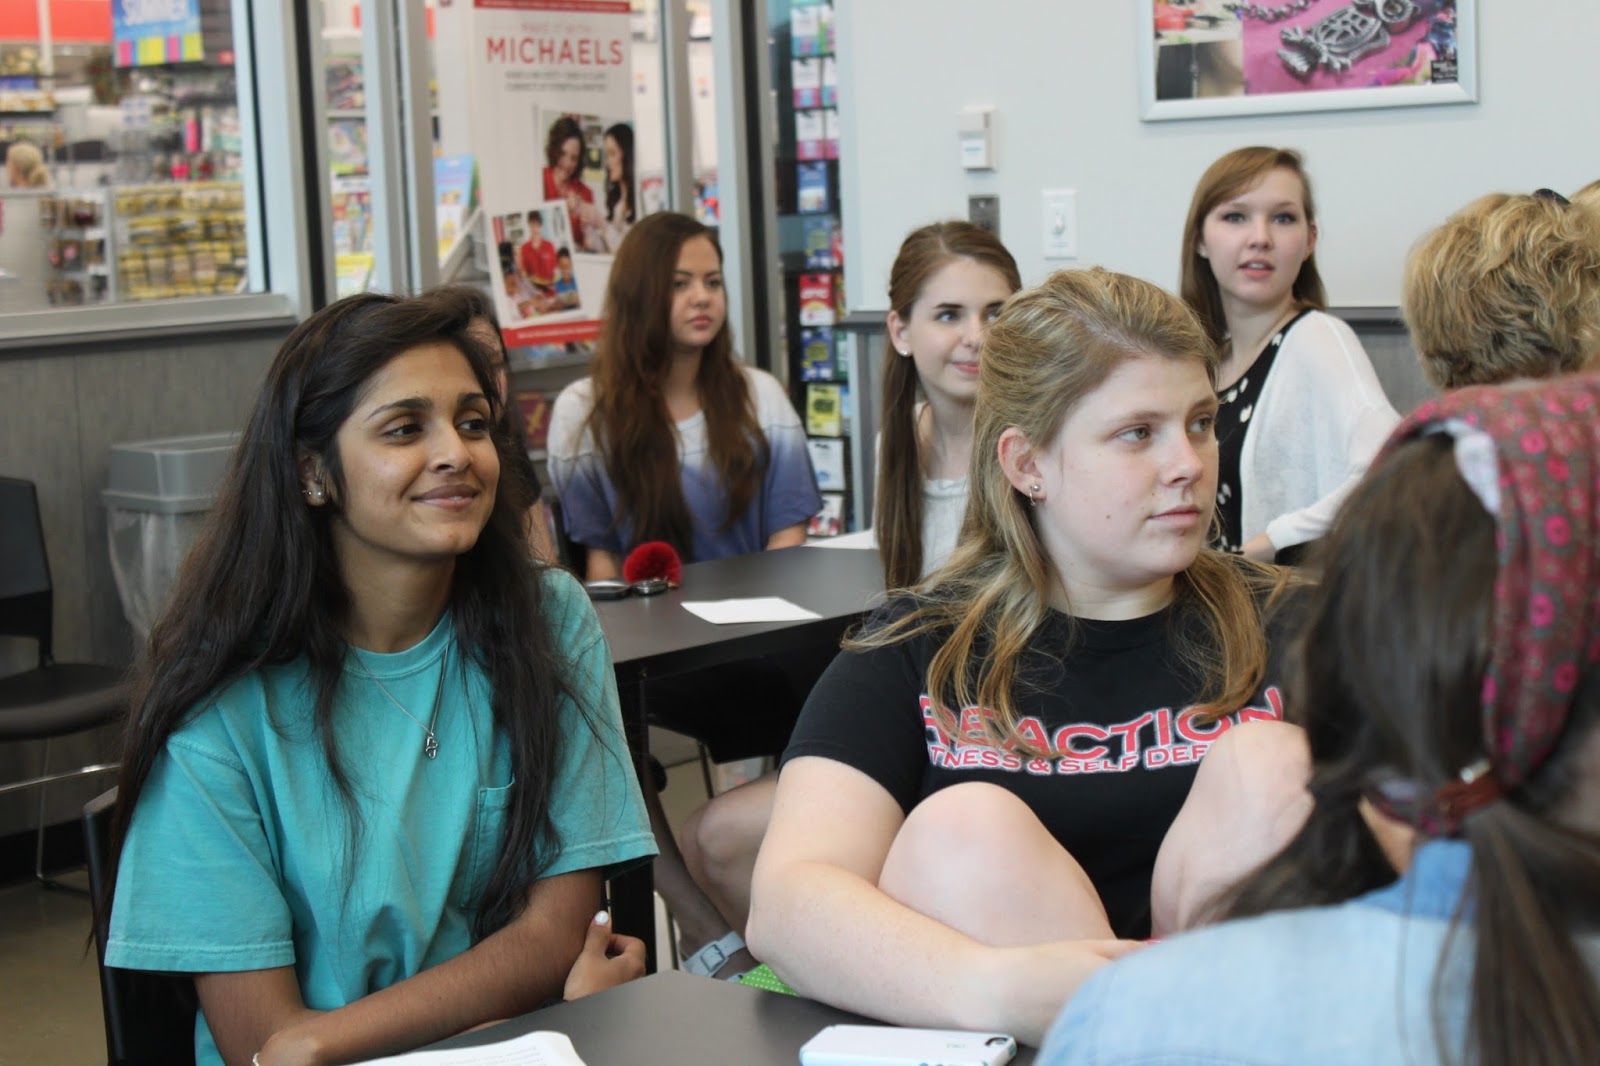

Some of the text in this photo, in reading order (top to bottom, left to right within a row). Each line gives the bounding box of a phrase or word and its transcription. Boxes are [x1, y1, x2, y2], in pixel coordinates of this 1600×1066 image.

[486, 37, 623, 65] MICHAELS
[929, 745, 1021, 769] TNESS
[1027, 756, 1050, 773] &
[1059, 756, 1137, 773] SELF
